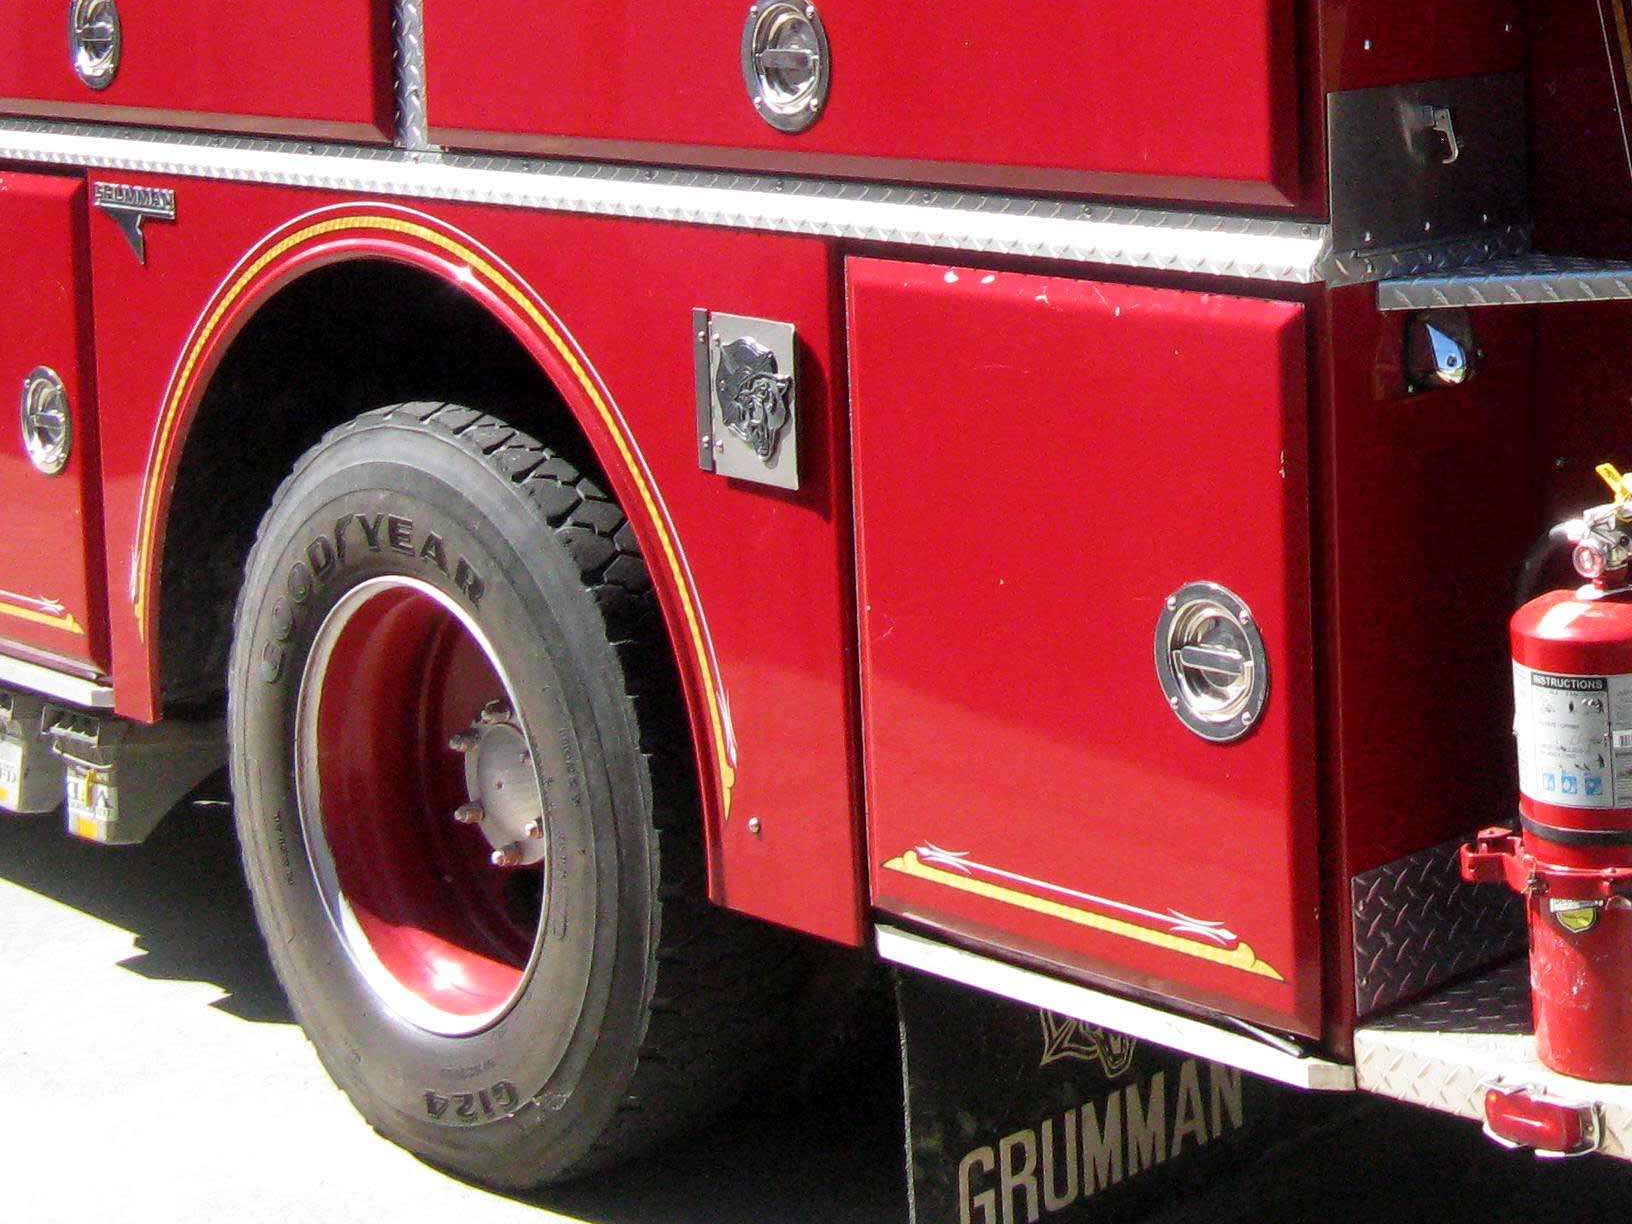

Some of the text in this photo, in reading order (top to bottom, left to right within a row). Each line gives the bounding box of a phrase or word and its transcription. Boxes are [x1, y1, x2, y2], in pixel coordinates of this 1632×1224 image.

[262, 512, 485, 684] GOODYEAR
[1533, 675, 1603, 690] INSTRUCTIONS
[958, 1059, 1243, 1224] GRUMMAN
